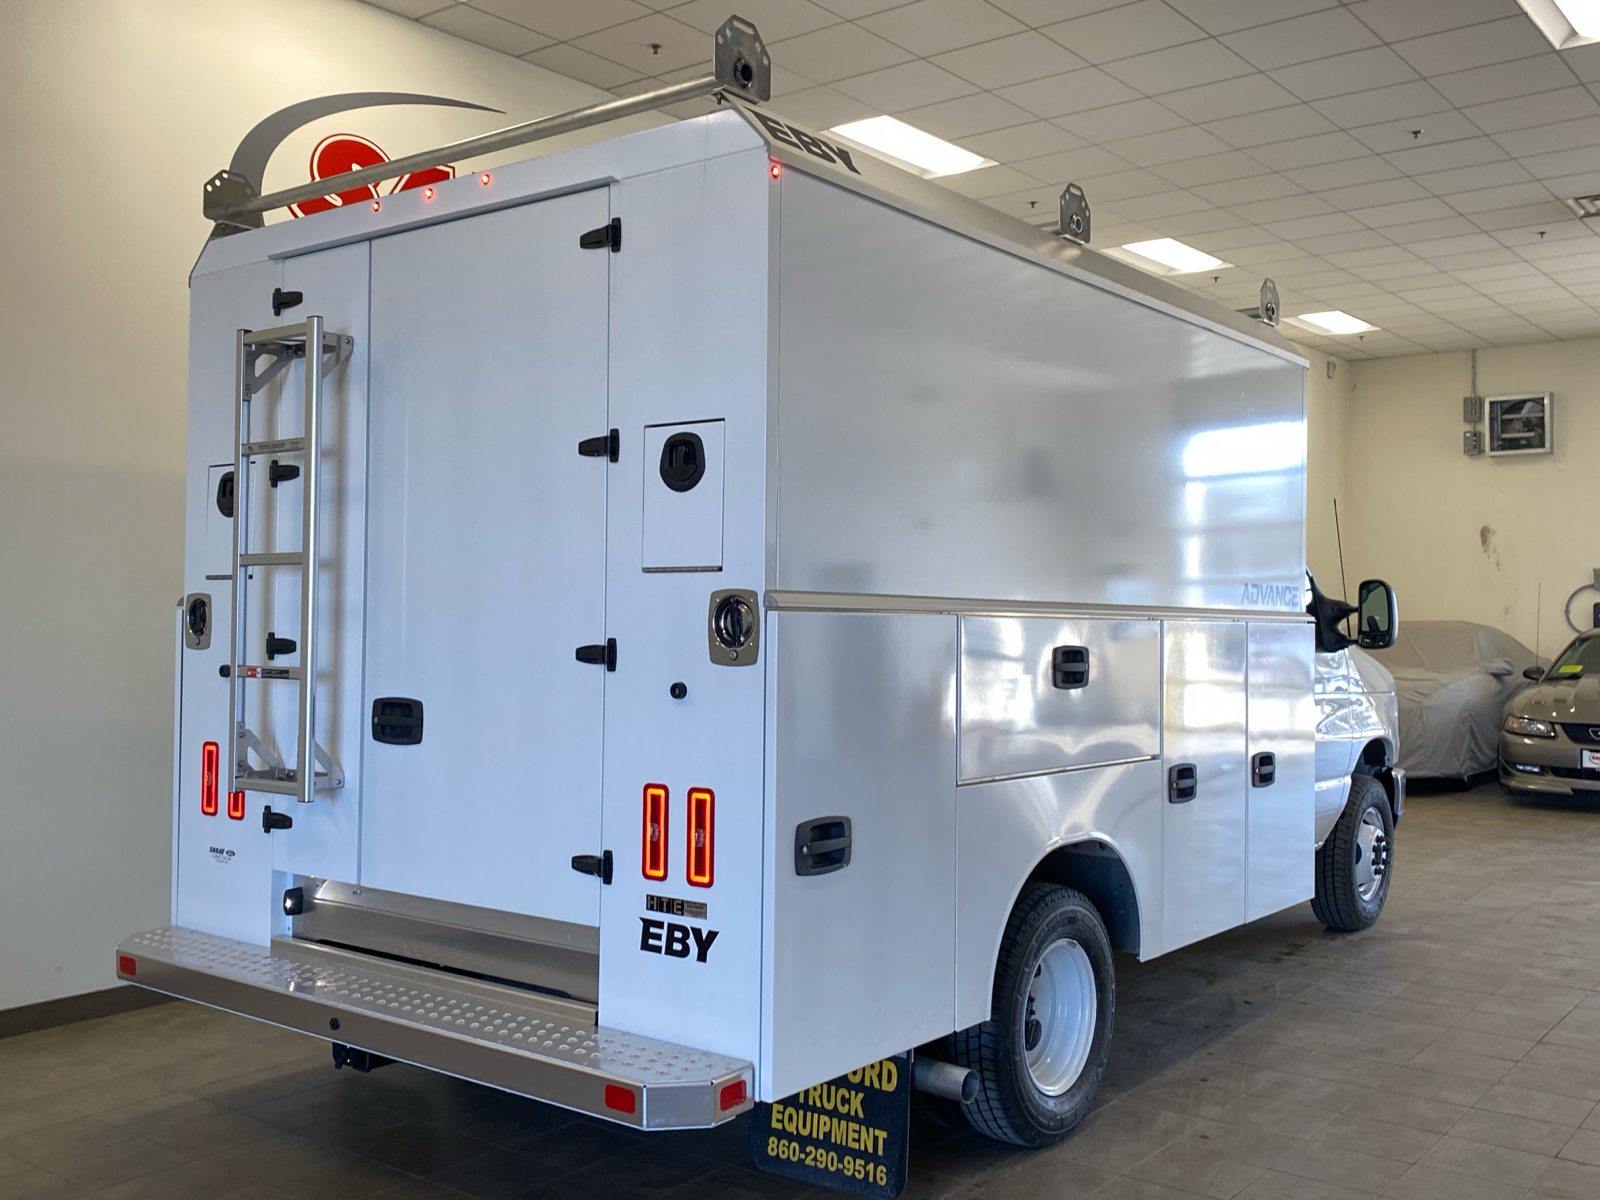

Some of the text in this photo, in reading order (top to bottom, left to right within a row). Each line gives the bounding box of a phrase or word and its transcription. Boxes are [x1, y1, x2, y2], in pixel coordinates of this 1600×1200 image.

[742, 105, 862, 175] EBY
[1241, 583, 1299, 607] ADVANCE
[638, 916, 720, 963] EBY
[771, 1103, 888, 1157] EQUIPMENT
[767, 1136, 887, 1186] 860-290-9516
